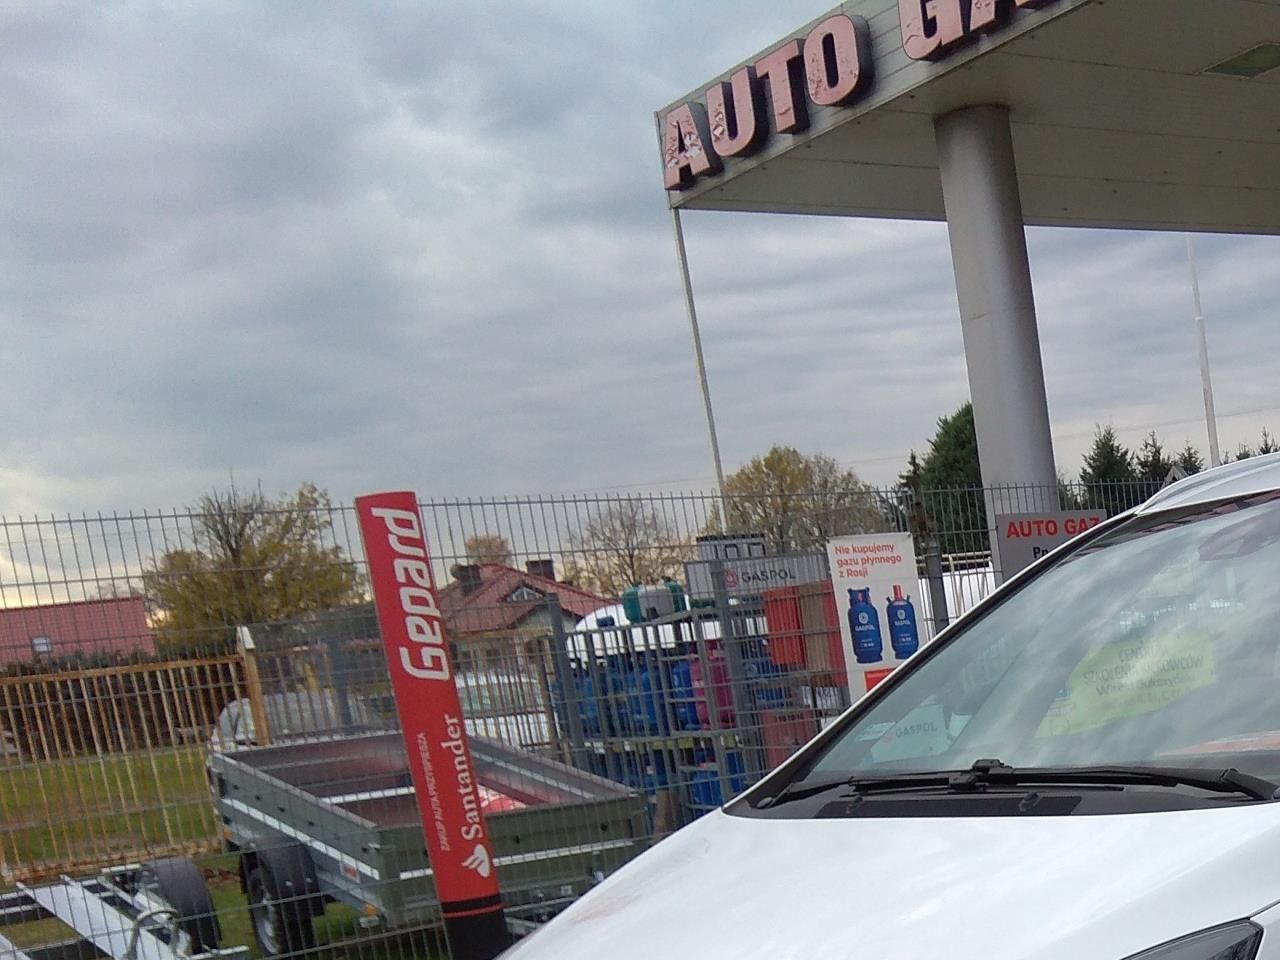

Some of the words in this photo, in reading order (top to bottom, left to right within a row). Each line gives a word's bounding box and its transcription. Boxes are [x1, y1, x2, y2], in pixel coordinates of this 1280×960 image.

[664, 14, 862, 190] AUTO
[1007, 520, 1058, 538] AUTO
[834, 545, 850, 554] Nie
[852, 543, 894, 554] kupujemy
[837, 557, 859, 568] gazu
[861, 555, 902, 566] płynnego
[741, 569, 796, 583] GASPOL
[839, 570, 845, 578] z
[846, 567, 868, 578] Rosji
[371, 507, 450, 680] Gepard
[895, 721, 938, 738] GASPOL
[440, 714, 483, 841] Santander
